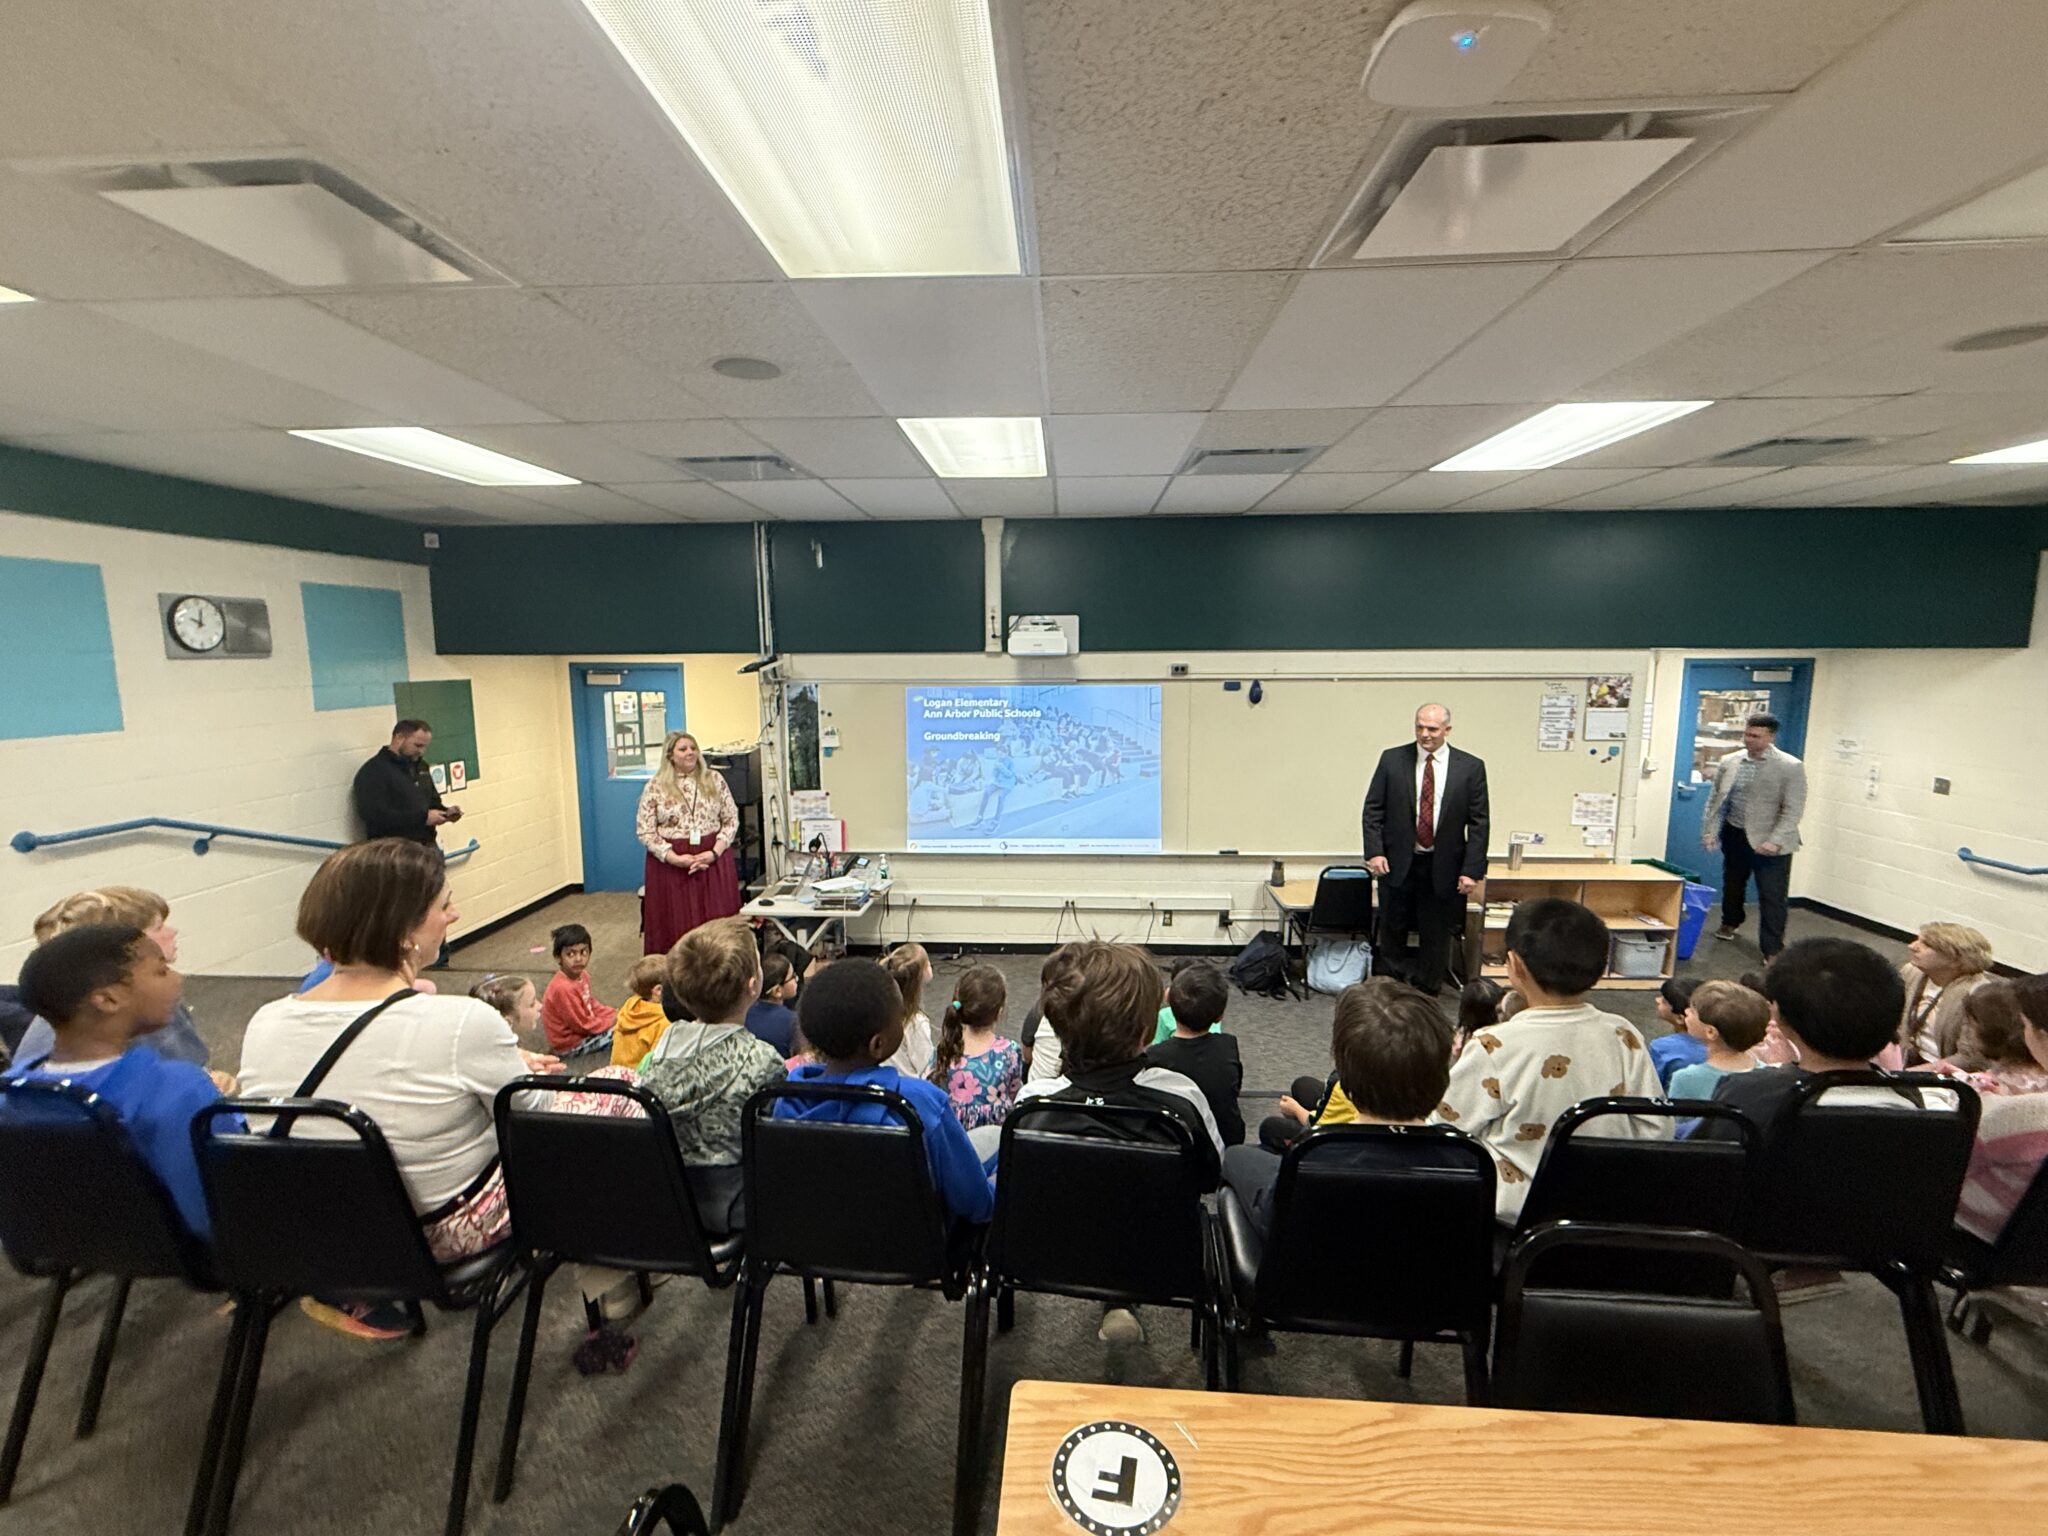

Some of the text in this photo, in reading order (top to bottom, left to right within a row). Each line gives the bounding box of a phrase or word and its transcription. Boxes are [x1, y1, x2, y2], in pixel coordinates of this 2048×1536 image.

[923, 698, 1009, 709] Logan Elementary
[923, 708, 1041, 719] Ann Arbor Public Schools
[923, 731, 1001, 742] Groundbreaking
[1091, 1455, 1138, 1508] F
